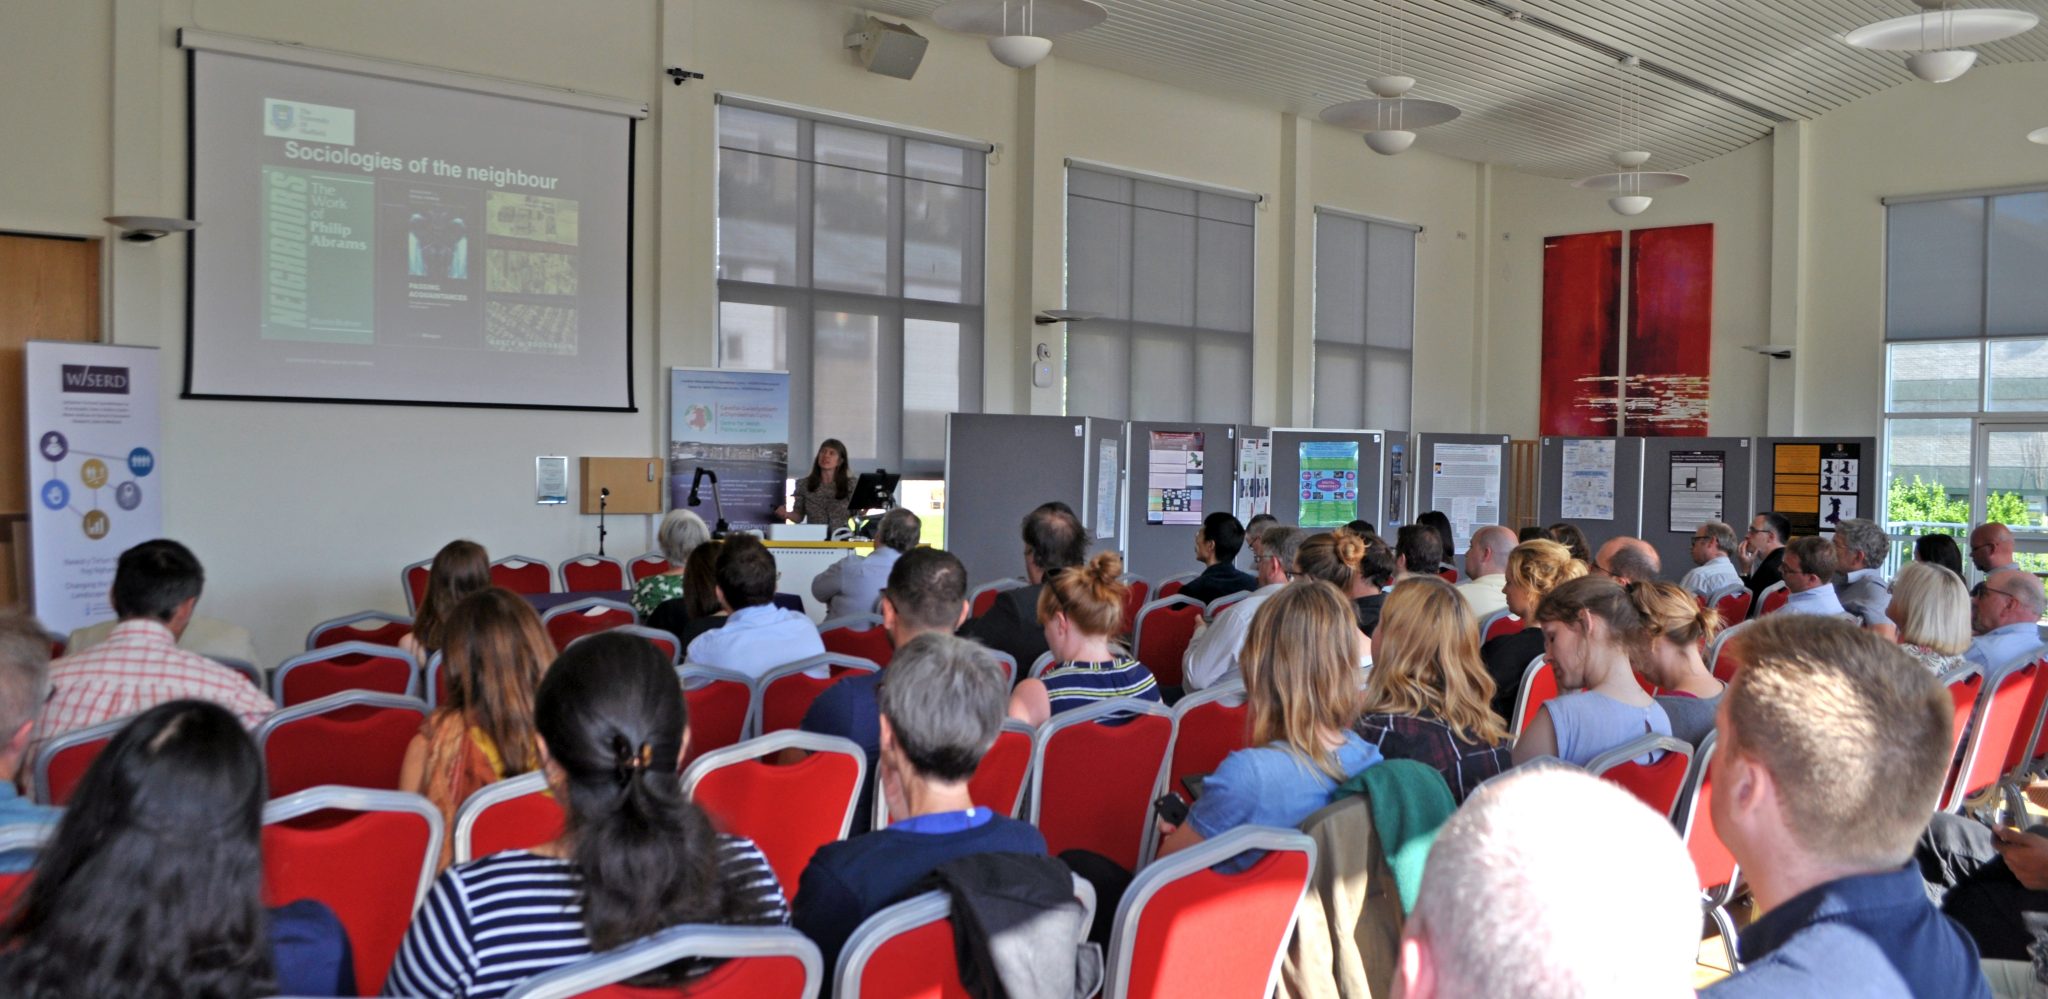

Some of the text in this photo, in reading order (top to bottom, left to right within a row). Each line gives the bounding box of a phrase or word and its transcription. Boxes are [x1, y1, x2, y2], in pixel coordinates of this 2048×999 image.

[285, 141, 558, 190] Sociologies of the neighbour
[311, 182, 336, 196] The
[311, 196, 348, 210] Work
[310, 208, 326, 220] of
[310, 221, 352, 238] Philip
[269, 171, 307, 329] NEIGHBOURS
[310, 235, 367, 250] Abrams
